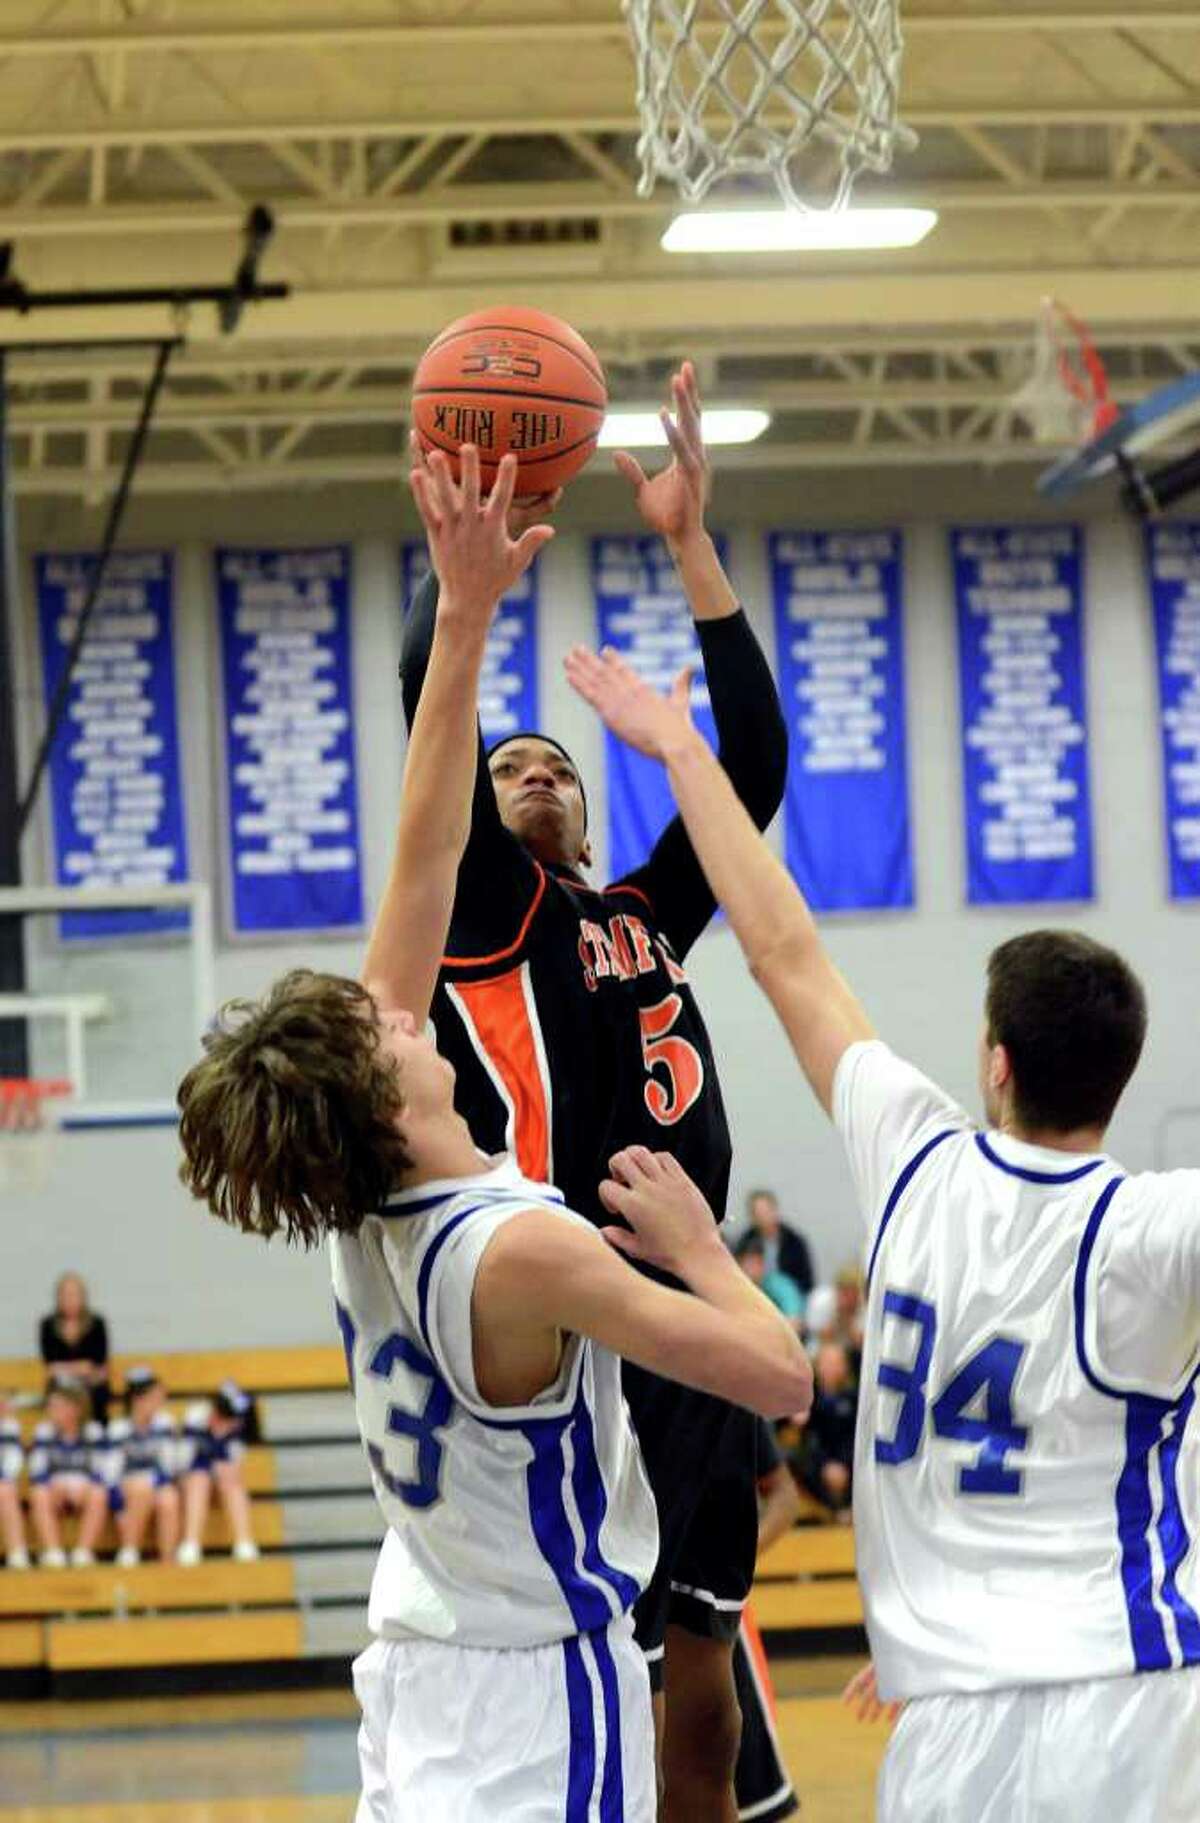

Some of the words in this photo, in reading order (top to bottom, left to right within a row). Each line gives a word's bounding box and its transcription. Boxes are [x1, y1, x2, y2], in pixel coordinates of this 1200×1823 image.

[510, 411, 567, 449] THE
[639, 992, 704, 1126] 5
[336, 1300, 454, 1507] 3
[875, 1290, 1028, 1494] 34
